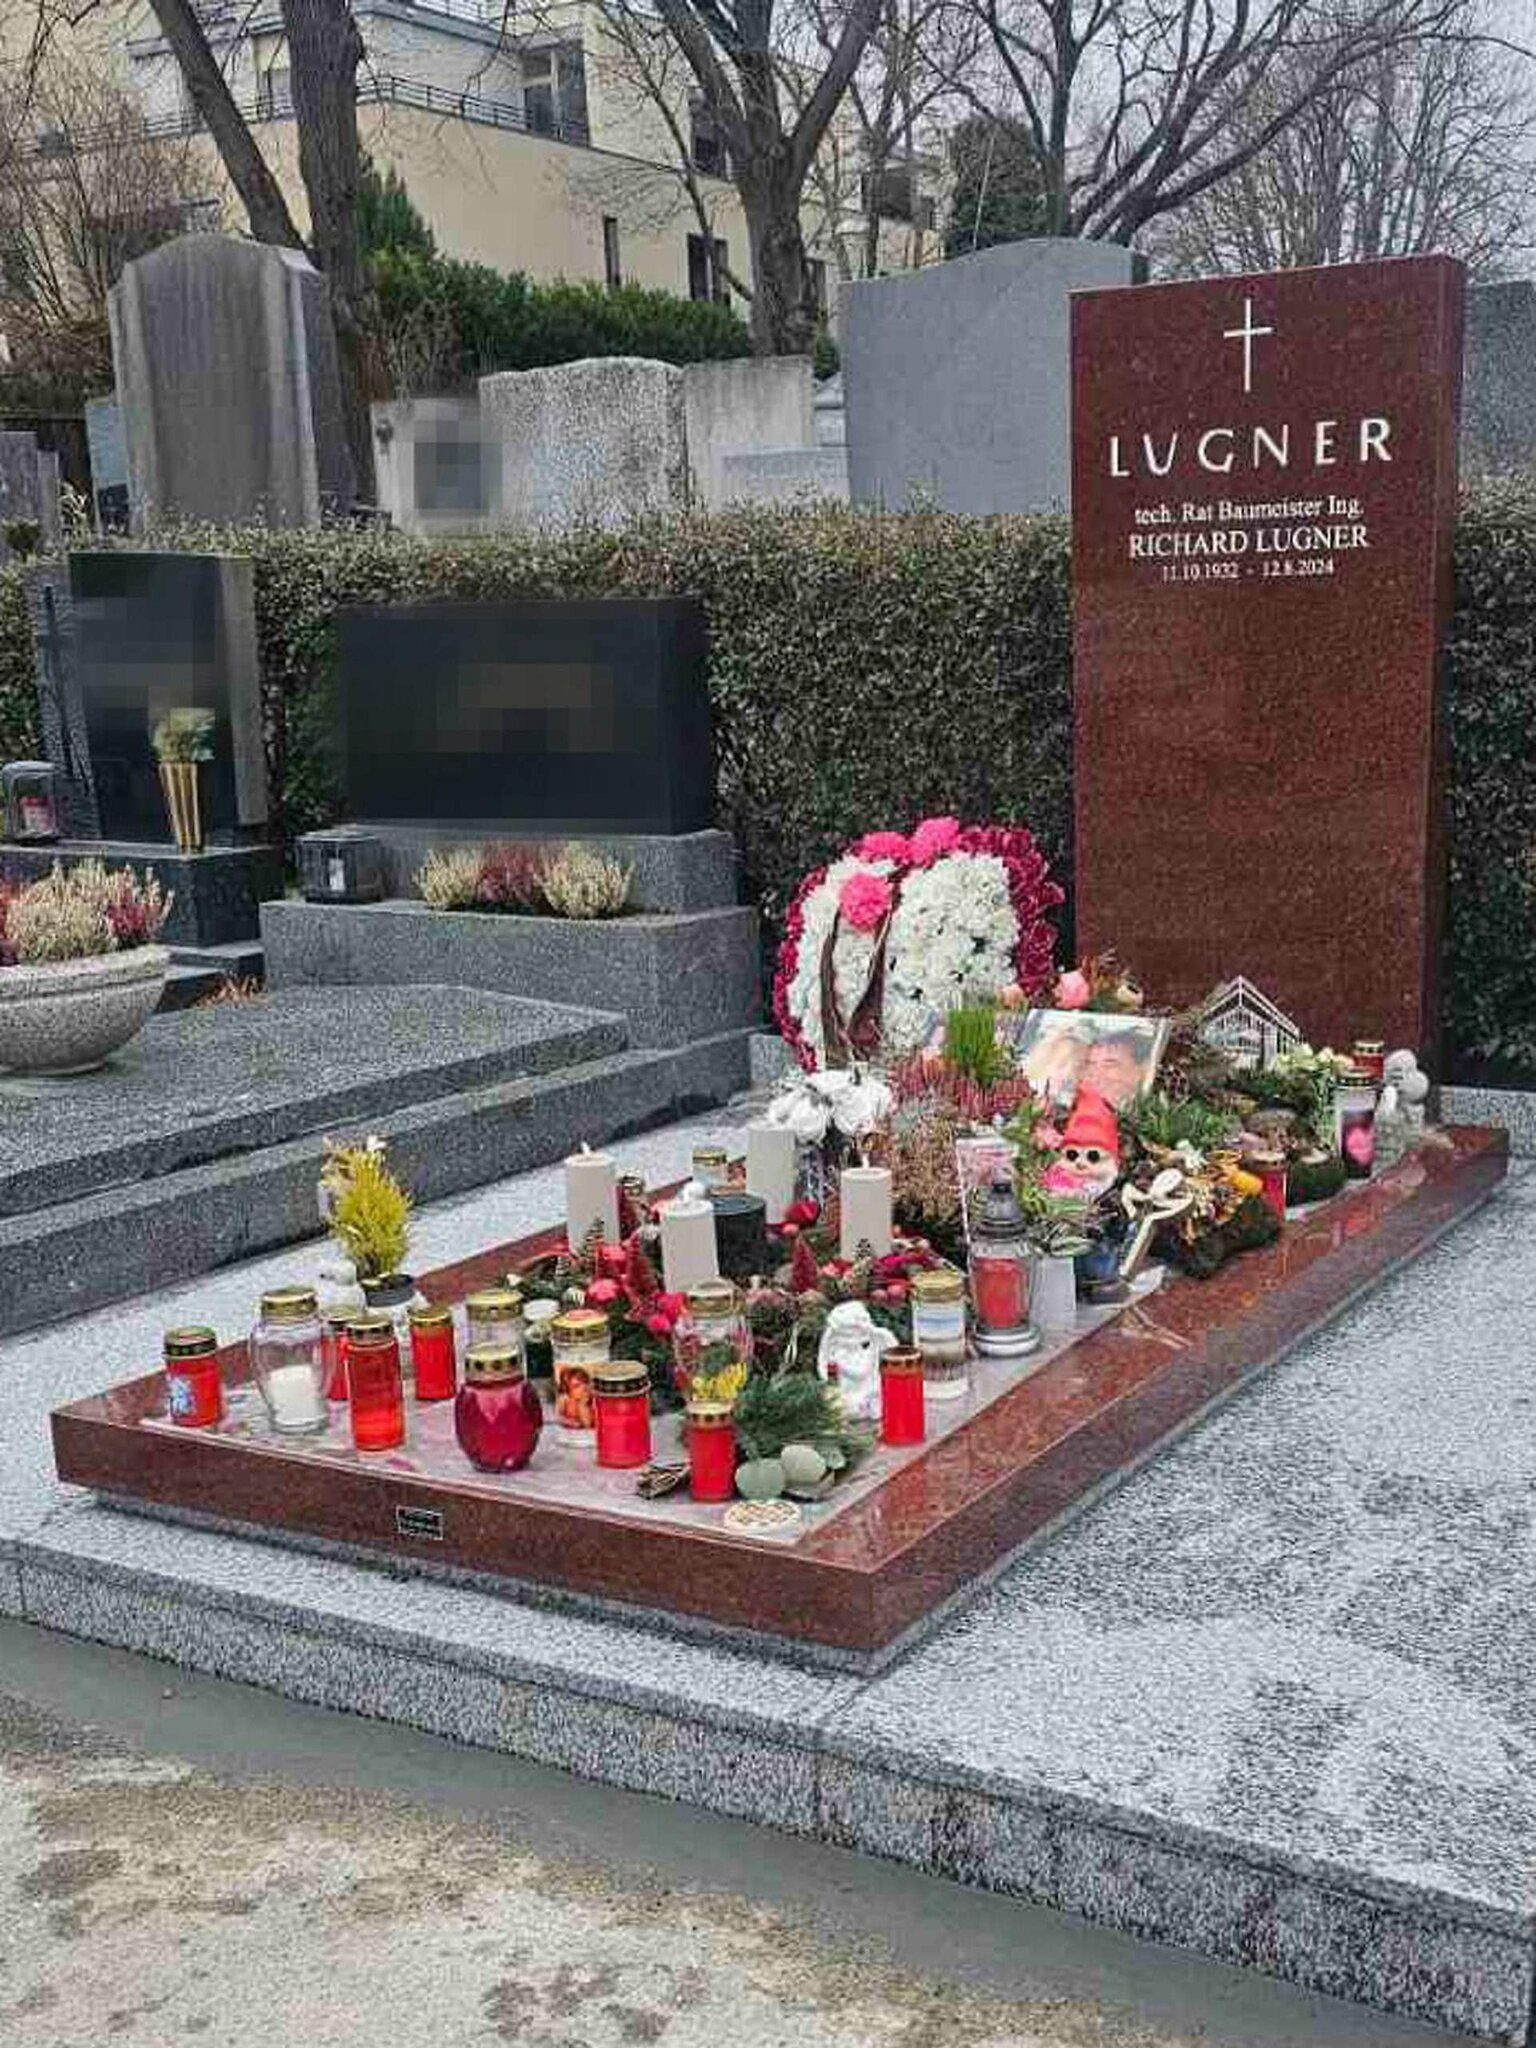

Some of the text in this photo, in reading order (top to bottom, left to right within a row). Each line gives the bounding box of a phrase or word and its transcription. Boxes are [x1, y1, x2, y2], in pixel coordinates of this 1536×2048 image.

[1109, 417, 1393, 478] LUGNER
[1182, 502, 1212, 523] Rat
[1218, 497, 1323, 521] Baumeister
[1328, 495, 1365, 519] Ing.
[1129, 524, 1369, 558] RICHARD LUGNER
